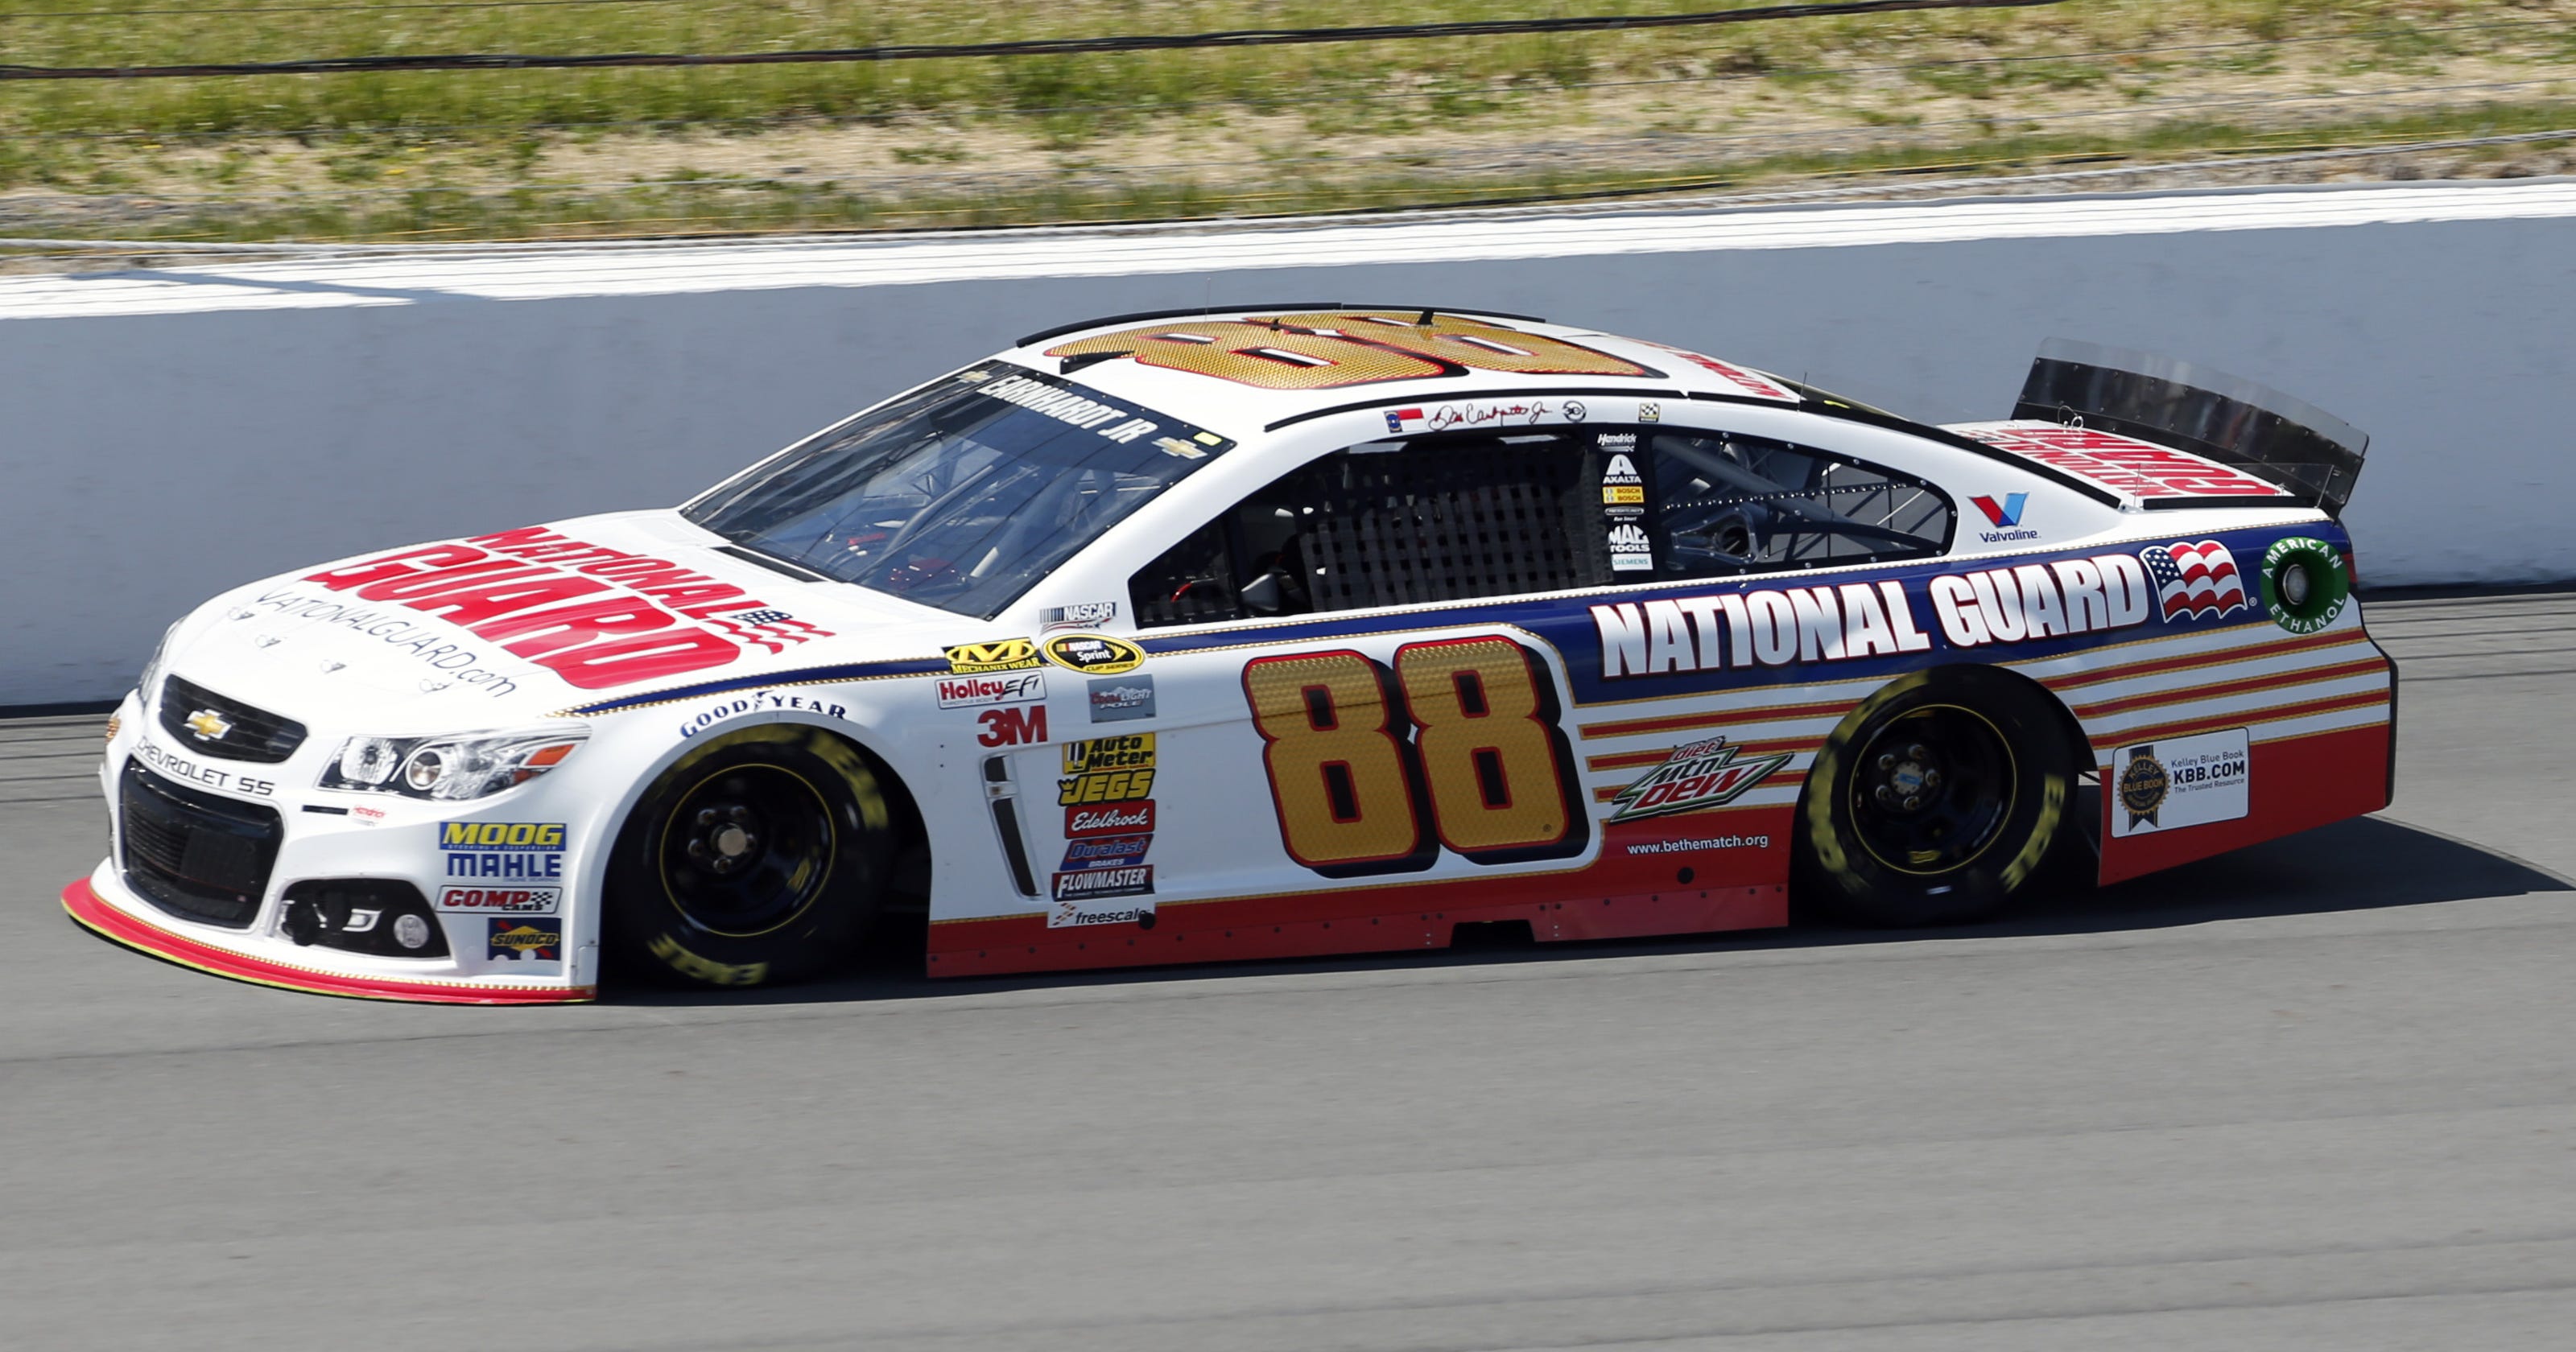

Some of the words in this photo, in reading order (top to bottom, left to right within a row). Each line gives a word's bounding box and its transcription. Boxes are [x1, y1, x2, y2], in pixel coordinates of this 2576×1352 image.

[976, 375, 1128, 429] EARNHARDT
[1097, 418, 1158, 443] JR
[1597, 434, 1637, 446] Hendrick
[1603, 476, 1642, 484] AXALTA
[1608, 524, 1649, 544] MAC
[1979, 530, 2038, 542] Valvoline
[1610, 544, 1650, 553] TOOLS
[2262, 538, 2343, 579] AMERICAN
[464, 526, 770, 620] NATIONAL
[299, 543, 741, 690] GUARD
[1063, 603, 1114, 621] NASCAR
[1589, 579, 1931, 679] NATIONAL
[1929, 553, 2149, 648] GUARD
[2269, 598, 2345, 633] ETHANOL
[951, 662, 1007, 674] MECHANIX
[1007, 657, 1041, 670] WEAR
[1076, 649, 1113, 662] Sprint
[939, 679, 1004, 701] Holley
[1121, 690, 1152, 702] LIGHT
[1100, 700, 1143, 710] POLE
[977, 705, 1047, 747] 3M
[1091, 735, 1141, 752] Auto
[1674, 741, 1716, 760] diet
[1088, 749, 1153, 769] Meter
[1242, 635, 1582, 873] 88
[2171, 758, 2198, 769] Kelley
[2200, 753, 2220, 765] Blue
[2223, 750, 2244, 760] Book
[135, 736, 231, 786] CHEVROLET
[237, 777, 275, 795] SS
[1653, 757, 1718, 784] Mtn
[2174, 760, 2245, 785] KBB.COM
[1059, 769, 1154, 805] JEGS
[2174, 785, 2186, 793] The
[2188, 782, 2213, 792] Trusted
[2214, 777, 2244, 788] Resource
[1071, 809, 1148, 831] Edelbrock
[442, 823, 564, 845] MOOG
[1070, 839, 1146, 859] Duralast
[1627, 835, 1769, 855] www.bethematch.org
[448, 853, 561, 876] MAHLE
[1088, 858, 1125, 868] BRAKES
[1057, 868, 1146, 898] FLOWMASTER
[444, 890, 530, 907] COMP
[493, 934, 556, 945] SUNOCO
